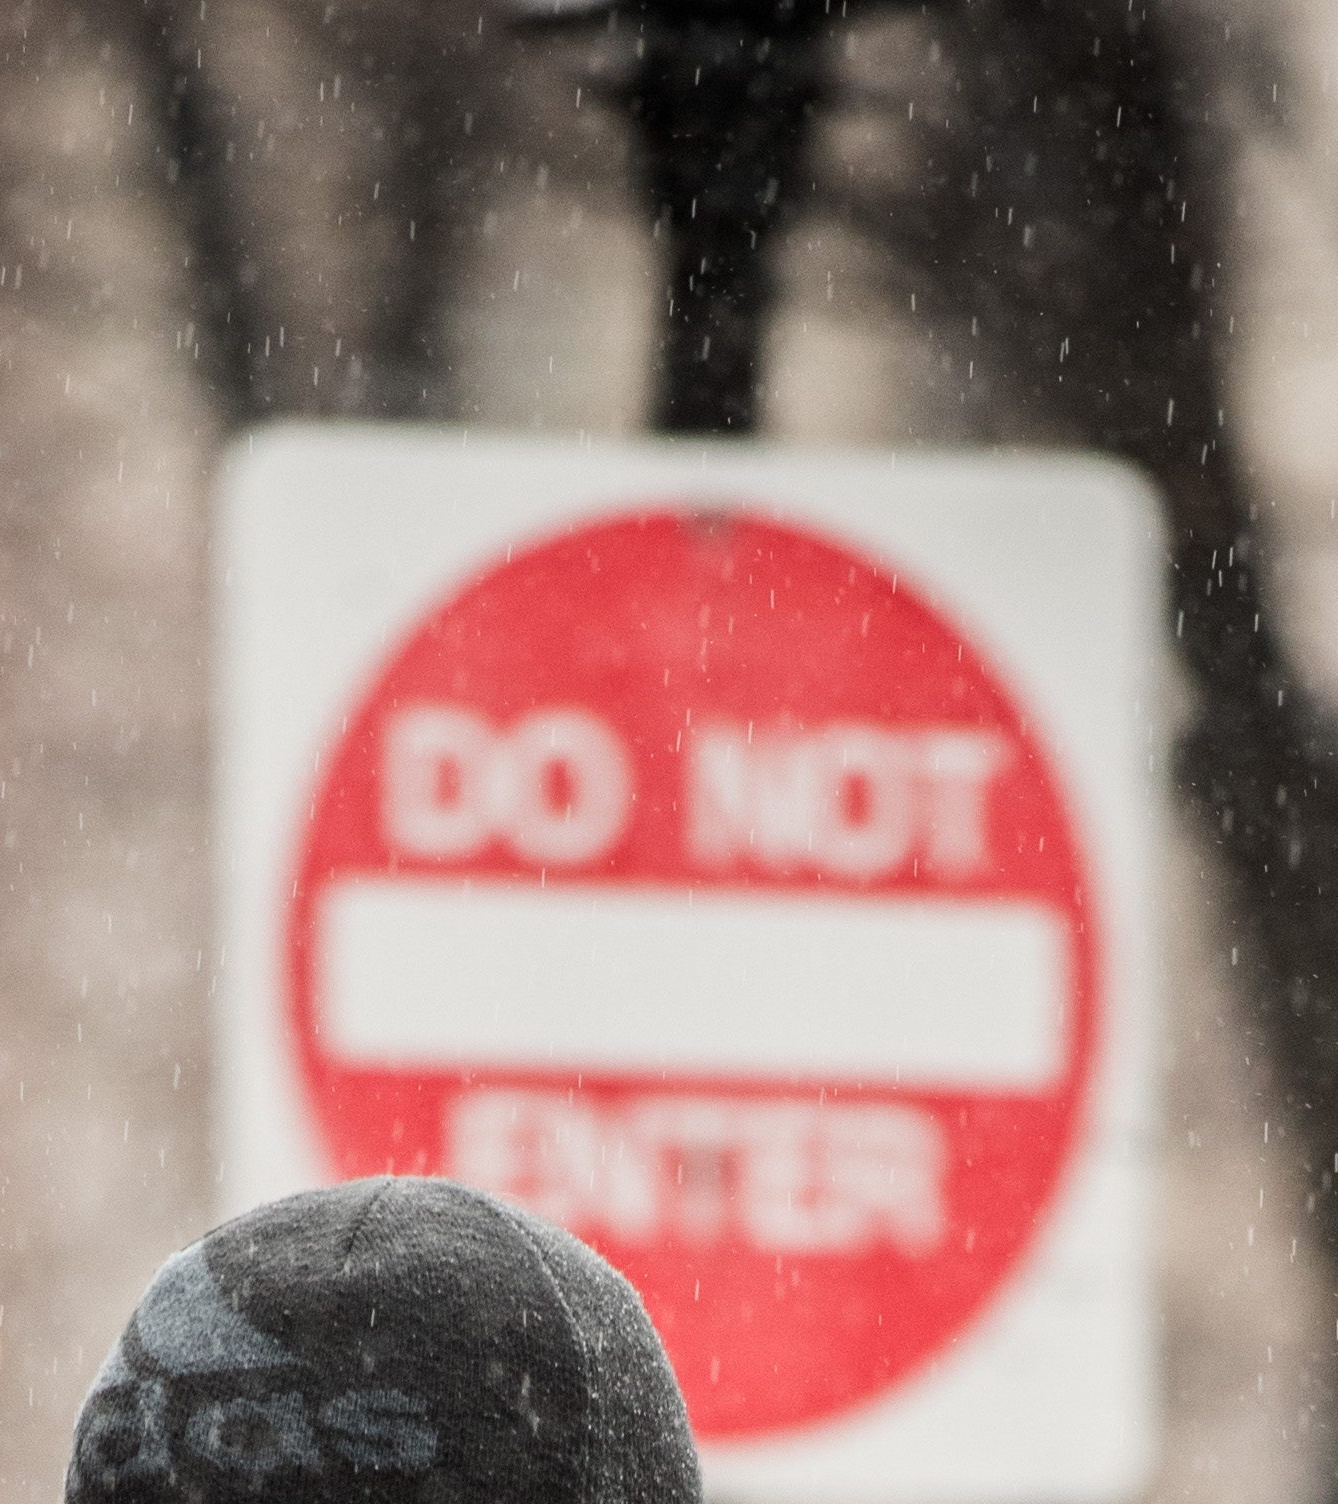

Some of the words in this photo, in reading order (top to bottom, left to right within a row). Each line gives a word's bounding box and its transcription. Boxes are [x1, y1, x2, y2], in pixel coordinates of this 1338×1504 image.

[383, 708, 635, 866] DO
[682, 718, 1007, 880] NOT
[451, 1092, 949, 1258] ENTER
